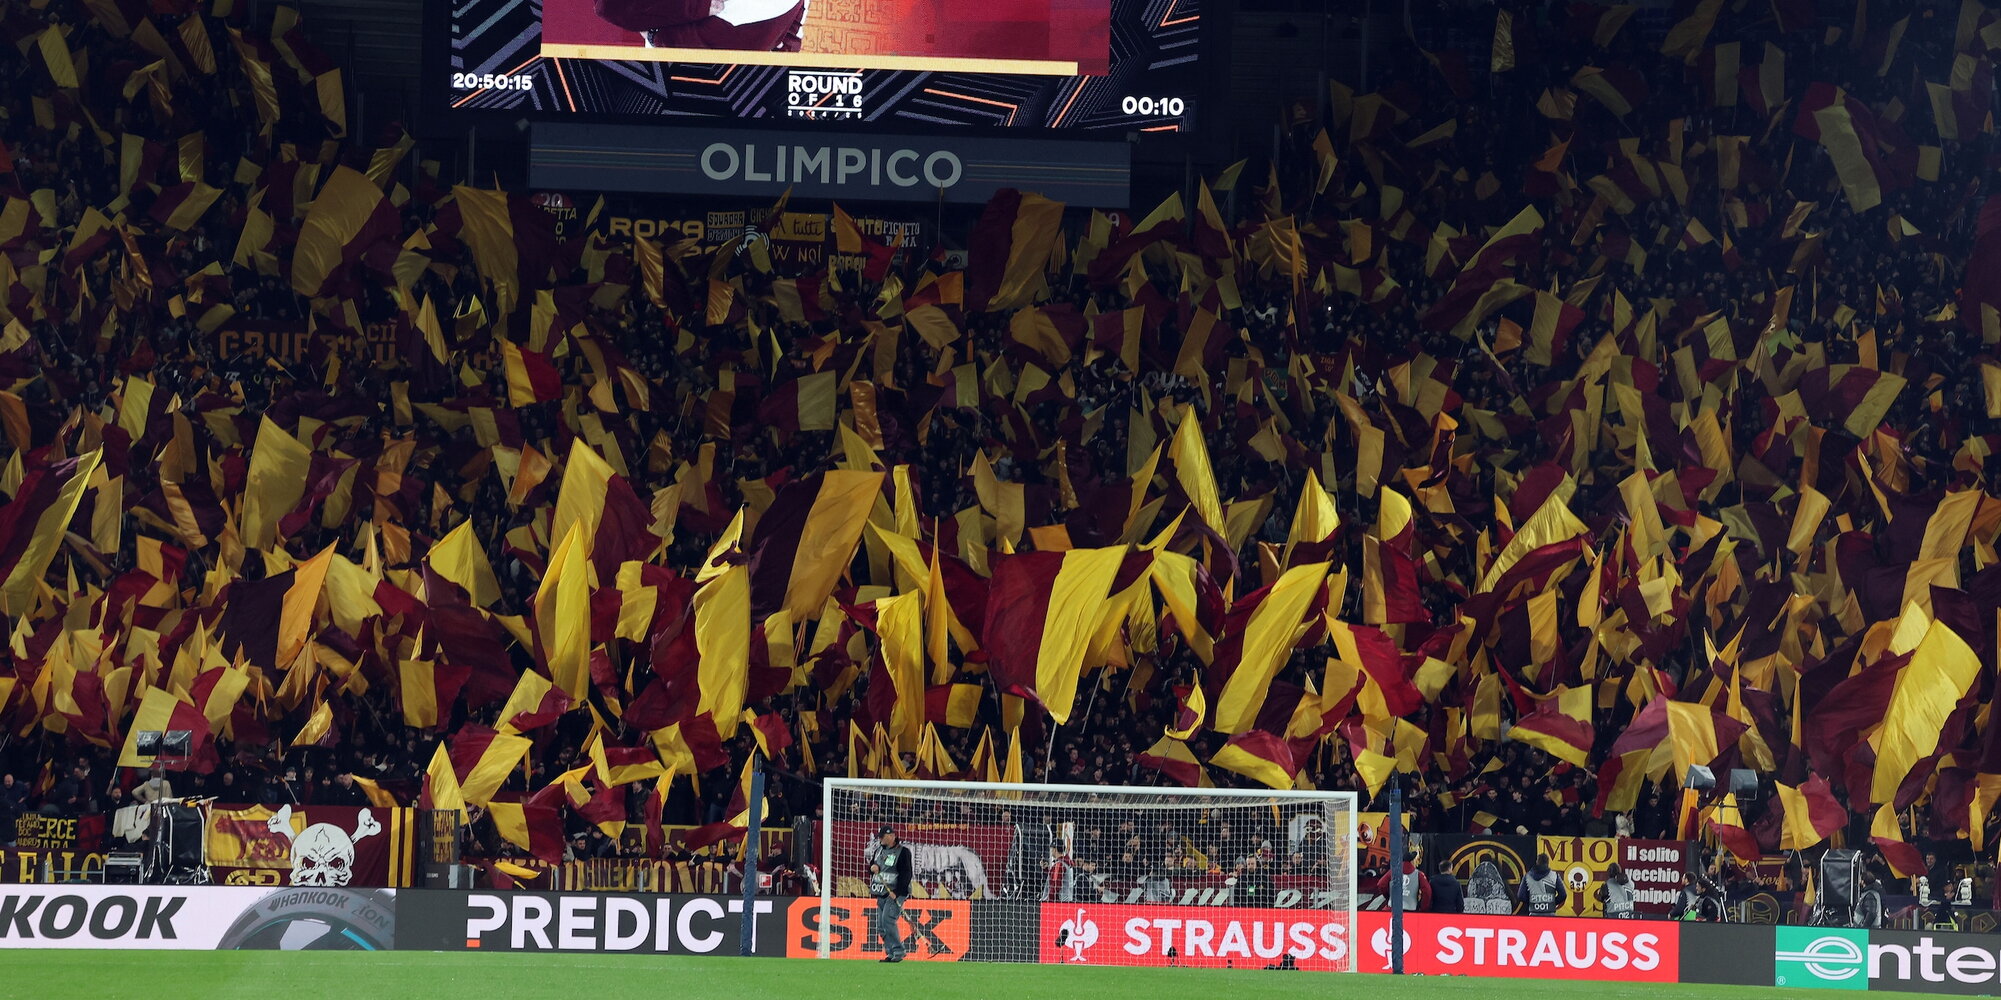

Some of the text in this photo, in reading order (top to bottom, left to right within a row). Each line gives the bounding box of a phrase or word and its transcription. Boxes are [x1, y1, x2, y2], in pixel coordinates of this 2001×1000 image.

[453, 72, 533, 91] 20:50:15
[788, 75, 863, 94] ROUND
[788, 92, 862, 108] OF 16
[1122, 96, 1184, 116] 00:10
[700, 142, 962, 188] OLIMPICO
[1627, 845, 1680, 863] il solito
[1633, 888, 1681, 905] anipol
[0, 894, 187, 940] KOOK
[1534, 903, 1549, 911] 001
[466, 894, 773, 953] PREDICT
[801, 906, 953, 955] SIX
[1123, 917, 1346, 959] STRAUSS
[1436, 927, 1661, 971] STRAUSS
